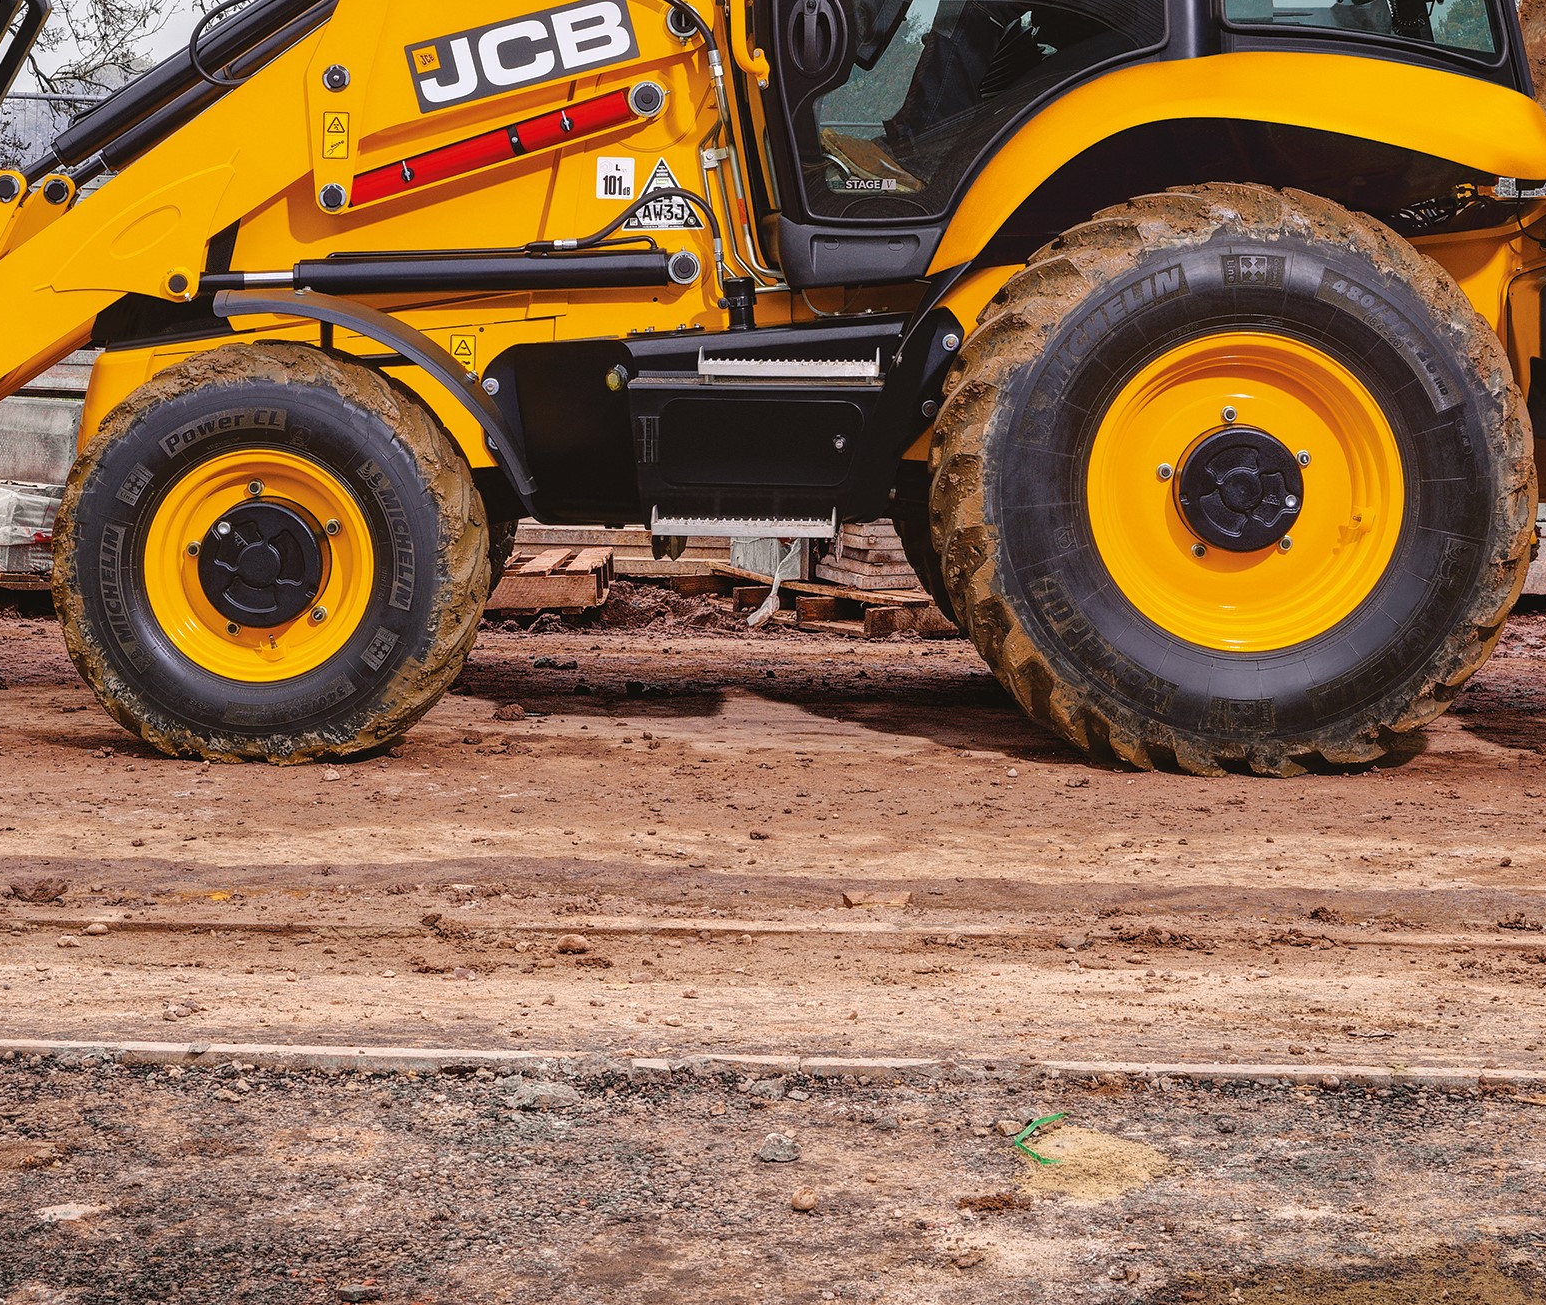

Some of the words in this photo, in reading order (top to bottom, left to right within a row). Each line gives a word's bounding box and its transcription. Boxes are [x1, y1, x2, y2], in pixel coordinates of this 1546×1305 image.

[420, 1, 631, 103] JCB
[643, 204, 684, 221] AW3J
[846, 180, 880, 189] STAGE
[1042, 266, 1181, 399] MICHELIN
[165, 414, 245, 453] Power
[254, 410, 281, 426] CL
[102, 527, 136, 645] MICHELIN
[378, 488, 415, 607] MICHELIN
